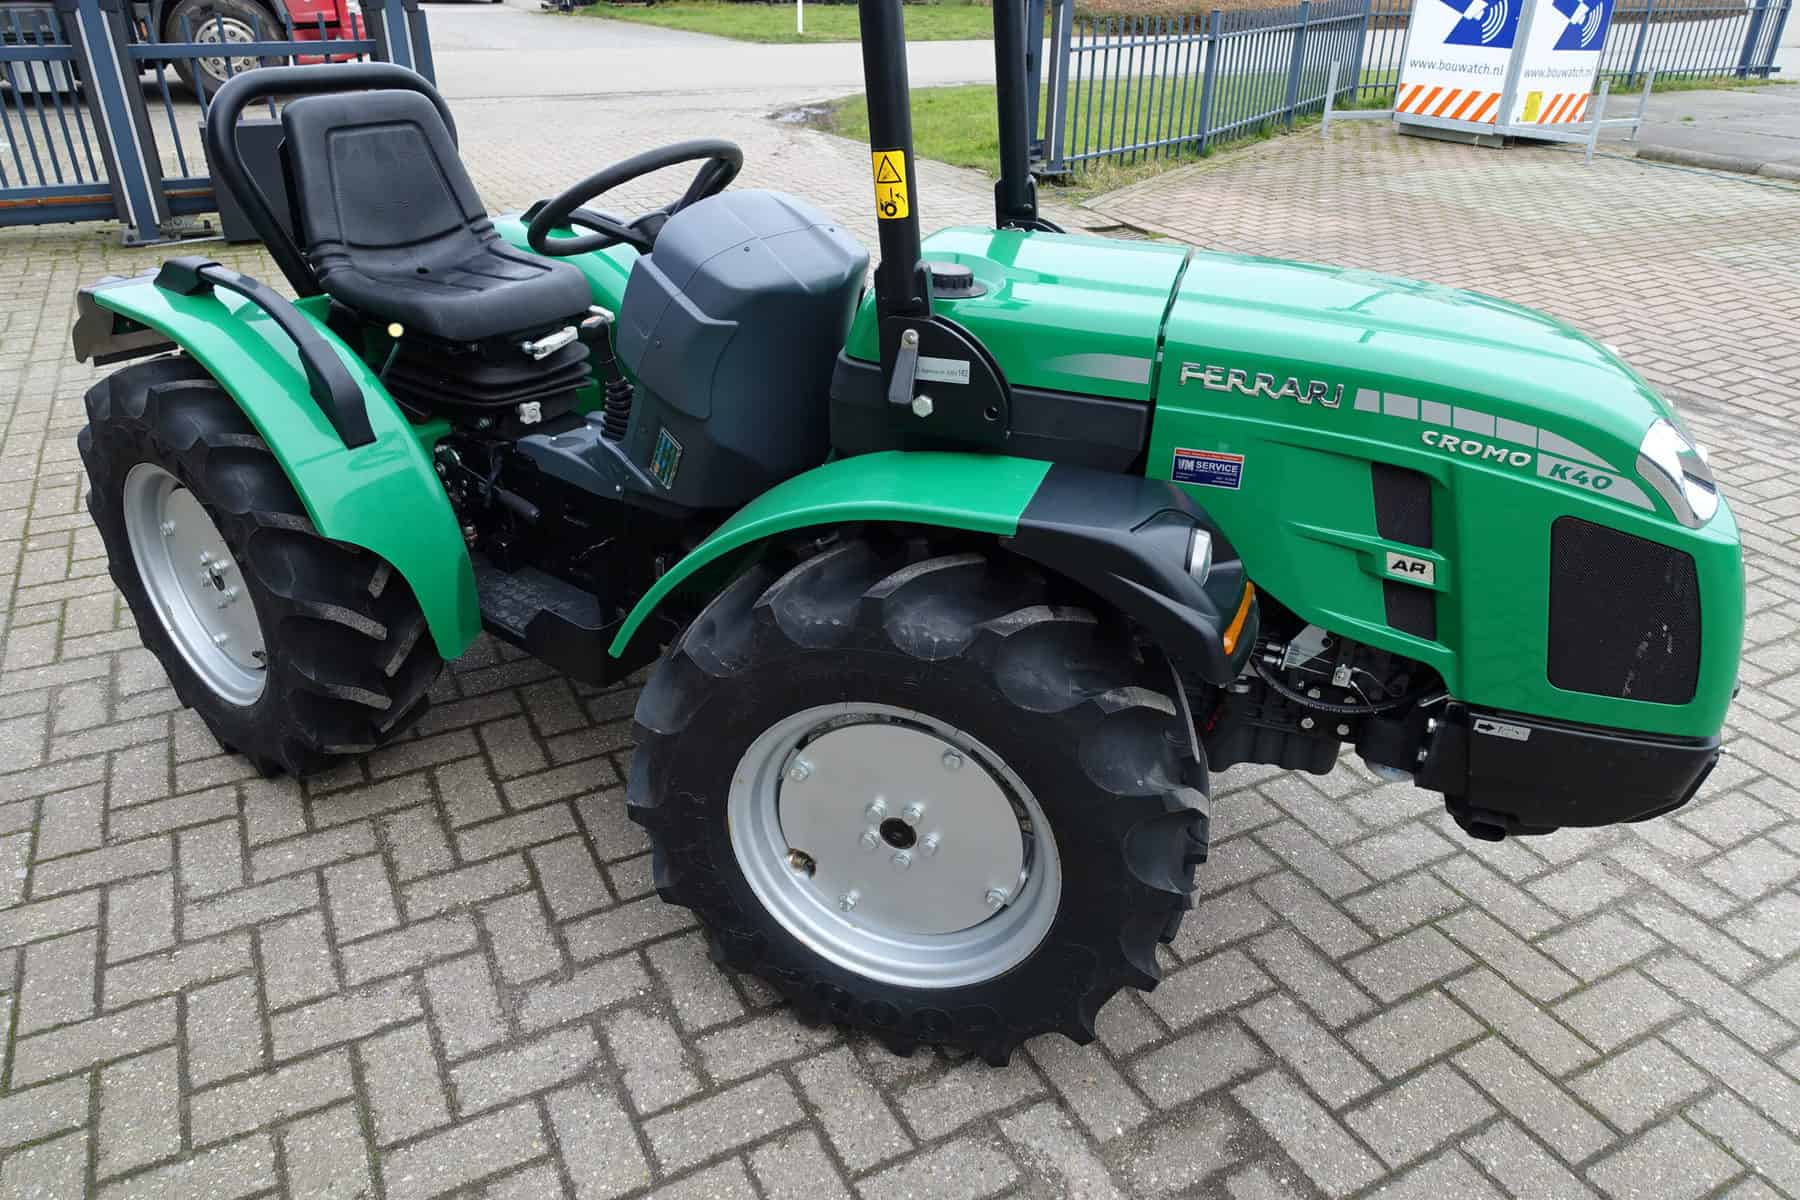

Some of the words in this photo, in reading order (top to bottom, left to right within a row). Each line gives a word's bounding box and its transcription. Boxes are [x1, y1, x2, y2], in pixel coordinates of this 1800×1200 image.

[1409, 56, 1505, 76] www.bouwatch.nl
[1179, 361, 1345, 409] FERRARI
[1421, 429, 1533, 467] CROMO
[1195, 460, 1239, 473] SERVICE
[1549, 462, 1613, 492] K40
[1391, 557, 1427, 577] AR
